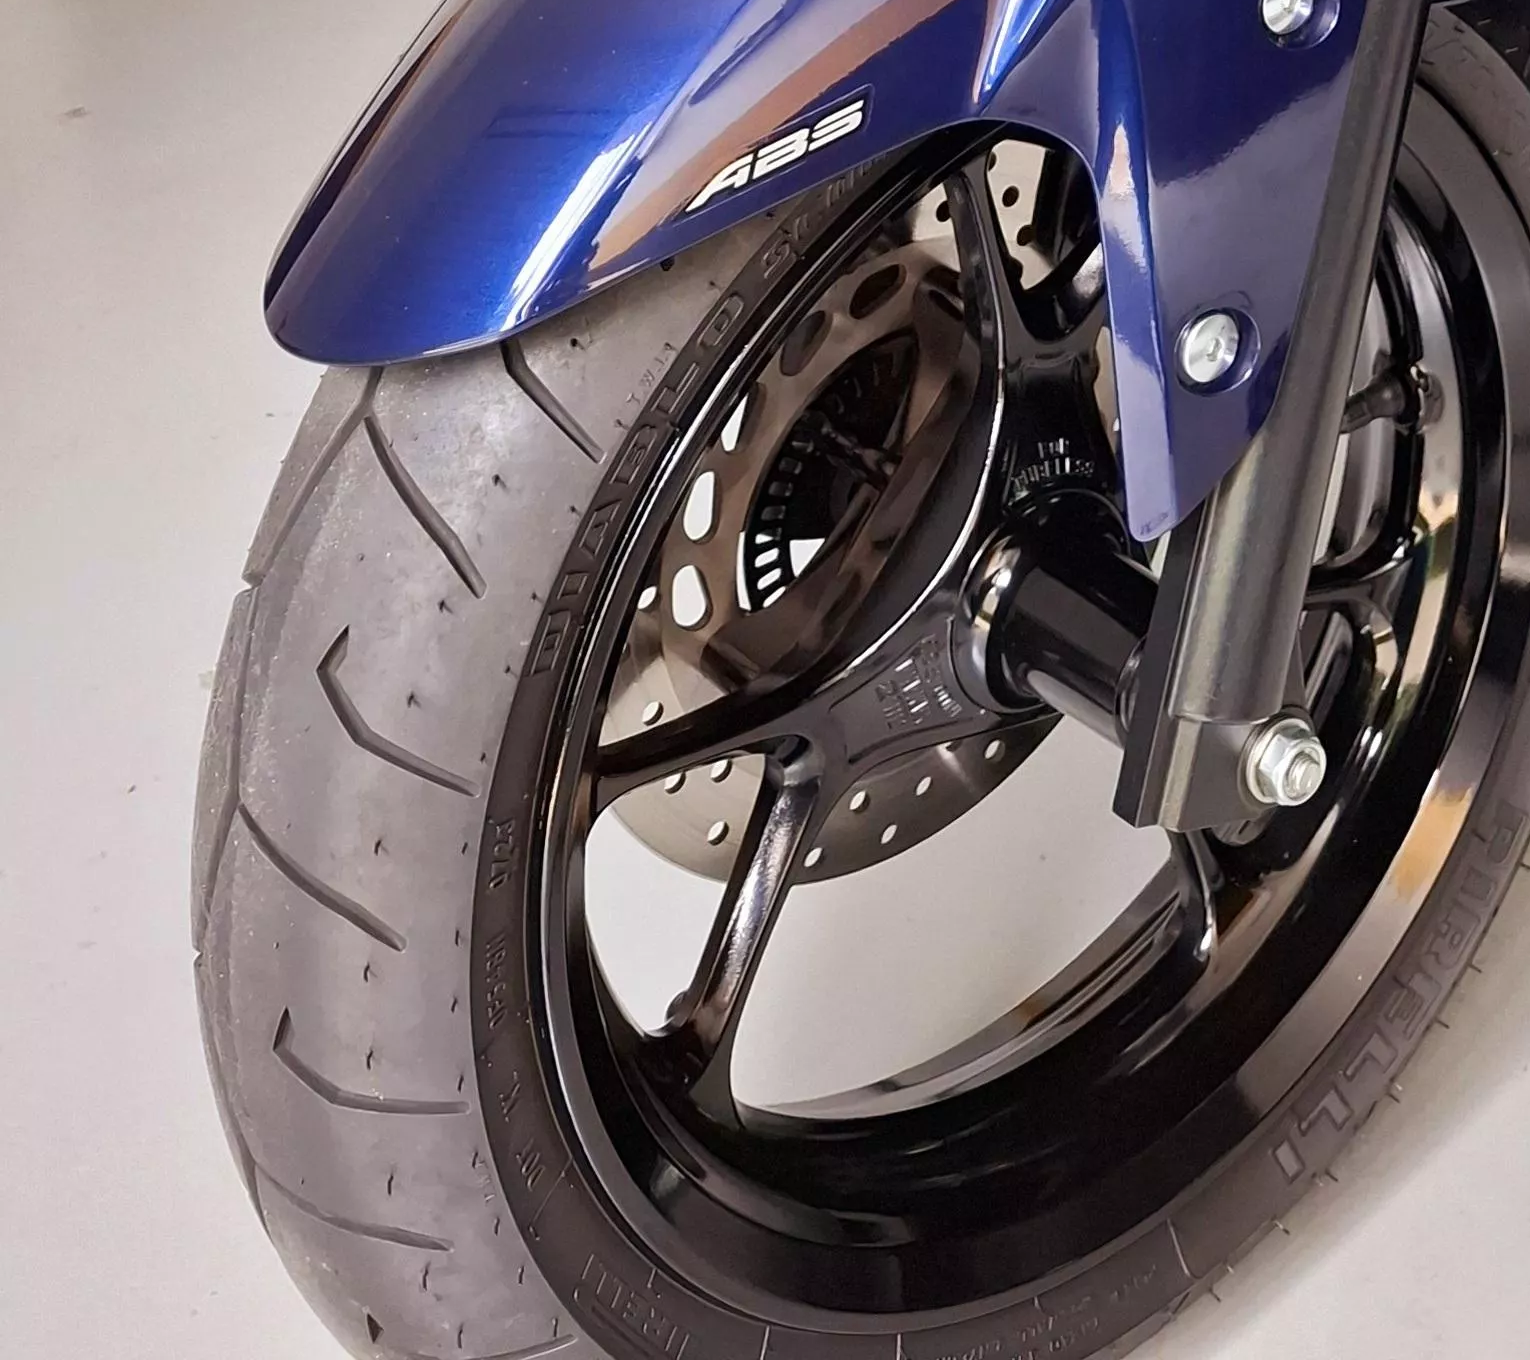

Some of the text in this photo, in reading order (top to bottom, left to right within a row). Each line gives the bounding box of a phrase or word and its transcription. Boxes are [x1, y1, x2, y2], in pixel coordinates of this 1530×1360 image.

[684, 98, 865, 213] ABS
[527, 292, 745, 677] DIABLO
[1269, 801, 1530, 1180] PIRELLI
